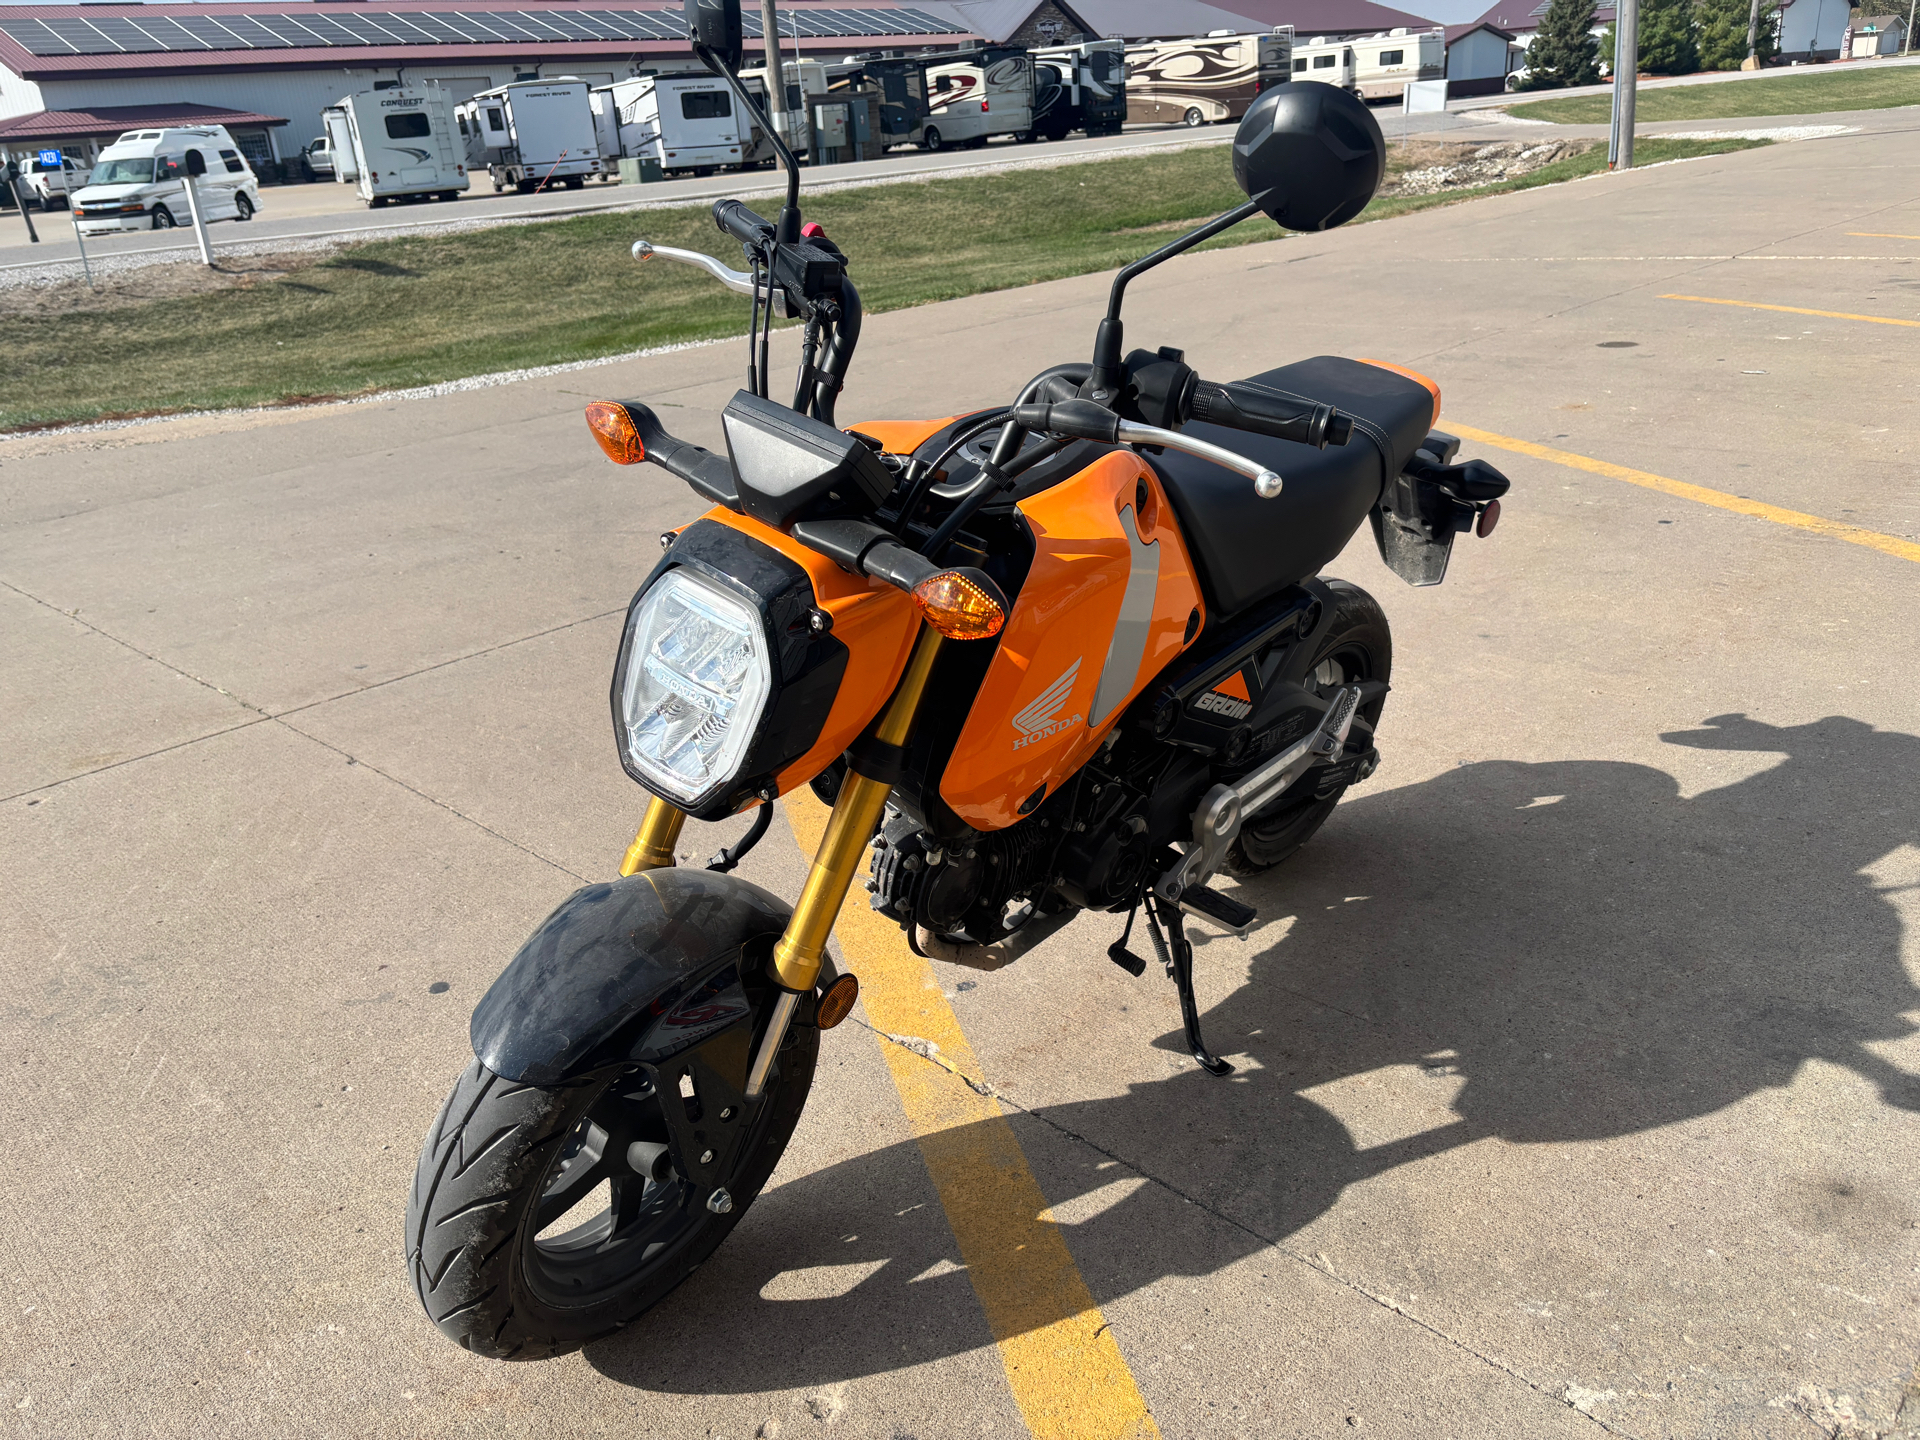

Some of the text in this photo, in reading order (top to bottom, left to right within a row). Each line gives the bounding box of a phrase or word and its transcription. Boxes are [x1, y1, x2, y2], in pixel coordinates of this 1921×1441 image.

[380, 97, 424, 107] CONQUEST
[40, 151, 58, 164] 14231
[660, 673, 711, 709] HONDA
[1193, 692, 1253, 720] GROM
[1012, 713, 1083, 751] HONDA
